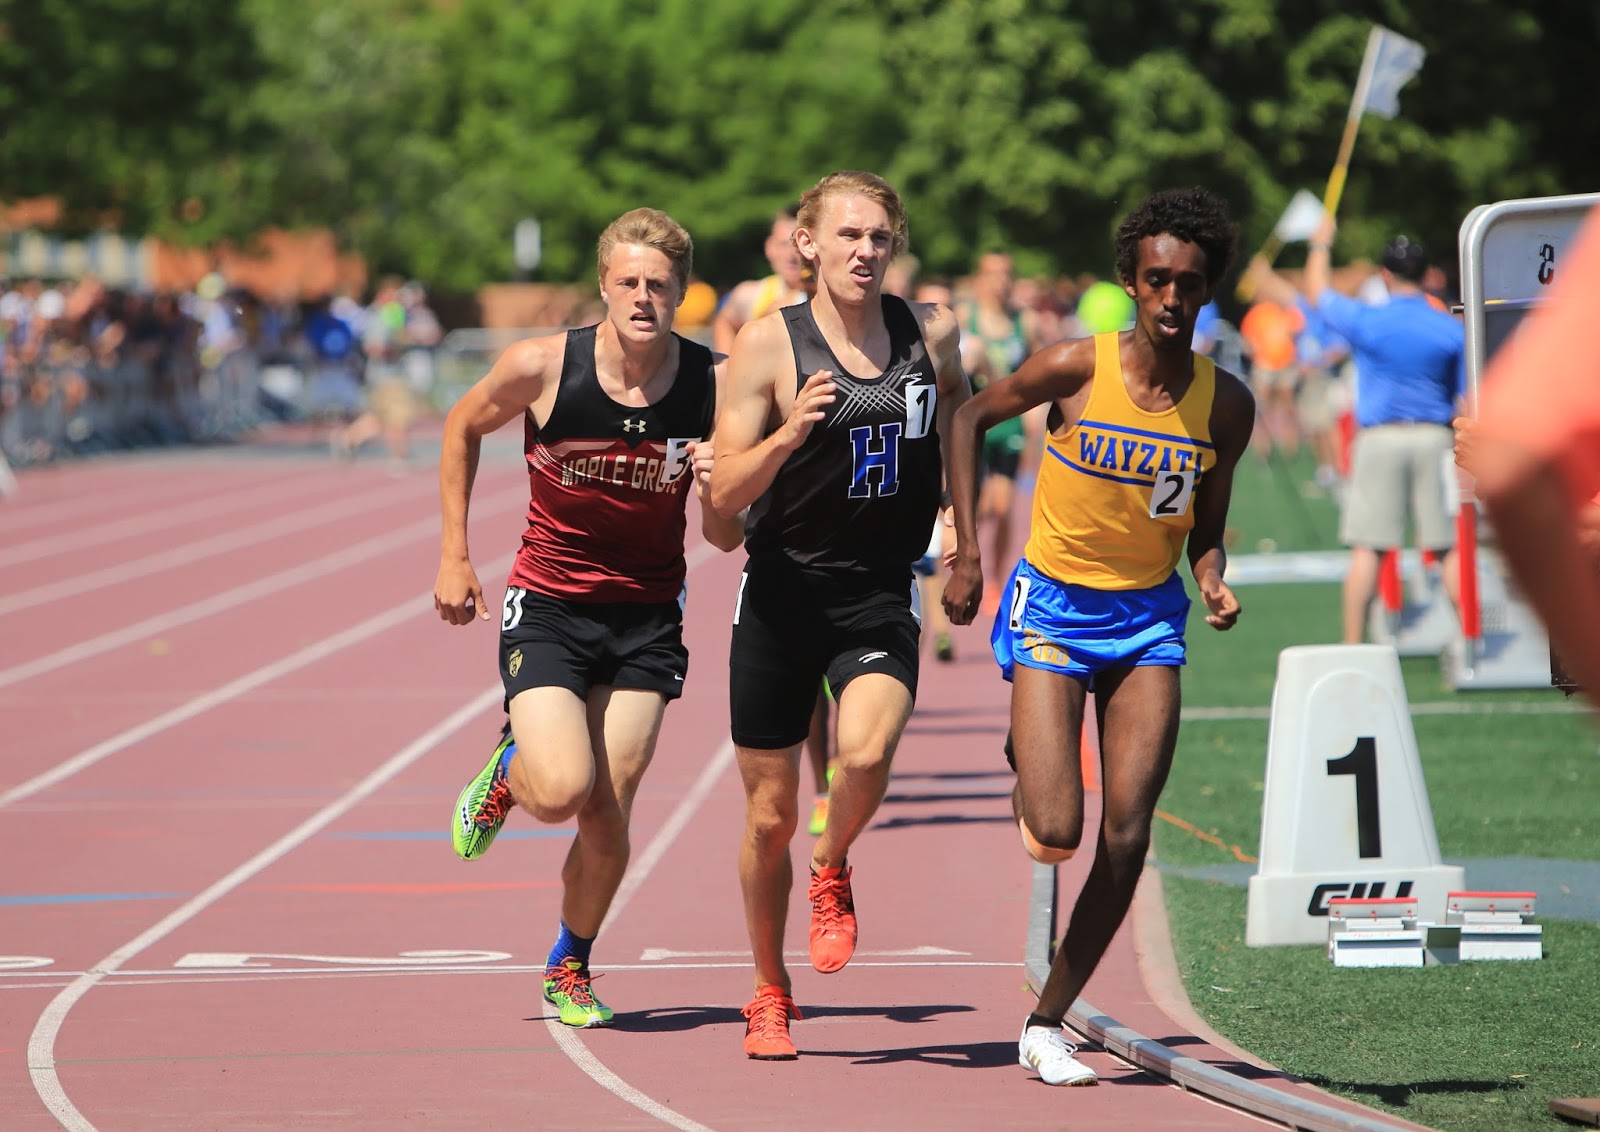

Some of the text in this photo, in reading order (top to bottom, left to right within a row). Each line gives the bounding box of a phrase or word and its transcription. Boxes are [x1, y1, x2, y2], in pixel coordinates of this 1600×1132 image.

[915, 388, 929, 435] 1
[561, 455, 681, 495] MAPLE GRO
[668, 441, 691, 481] 3
[848, 421, 902, 499] H
[1156, 474, 1185, 515] 2
[504, 586, 520, 628] 3
[1326, 736, 1382, 859] 1
